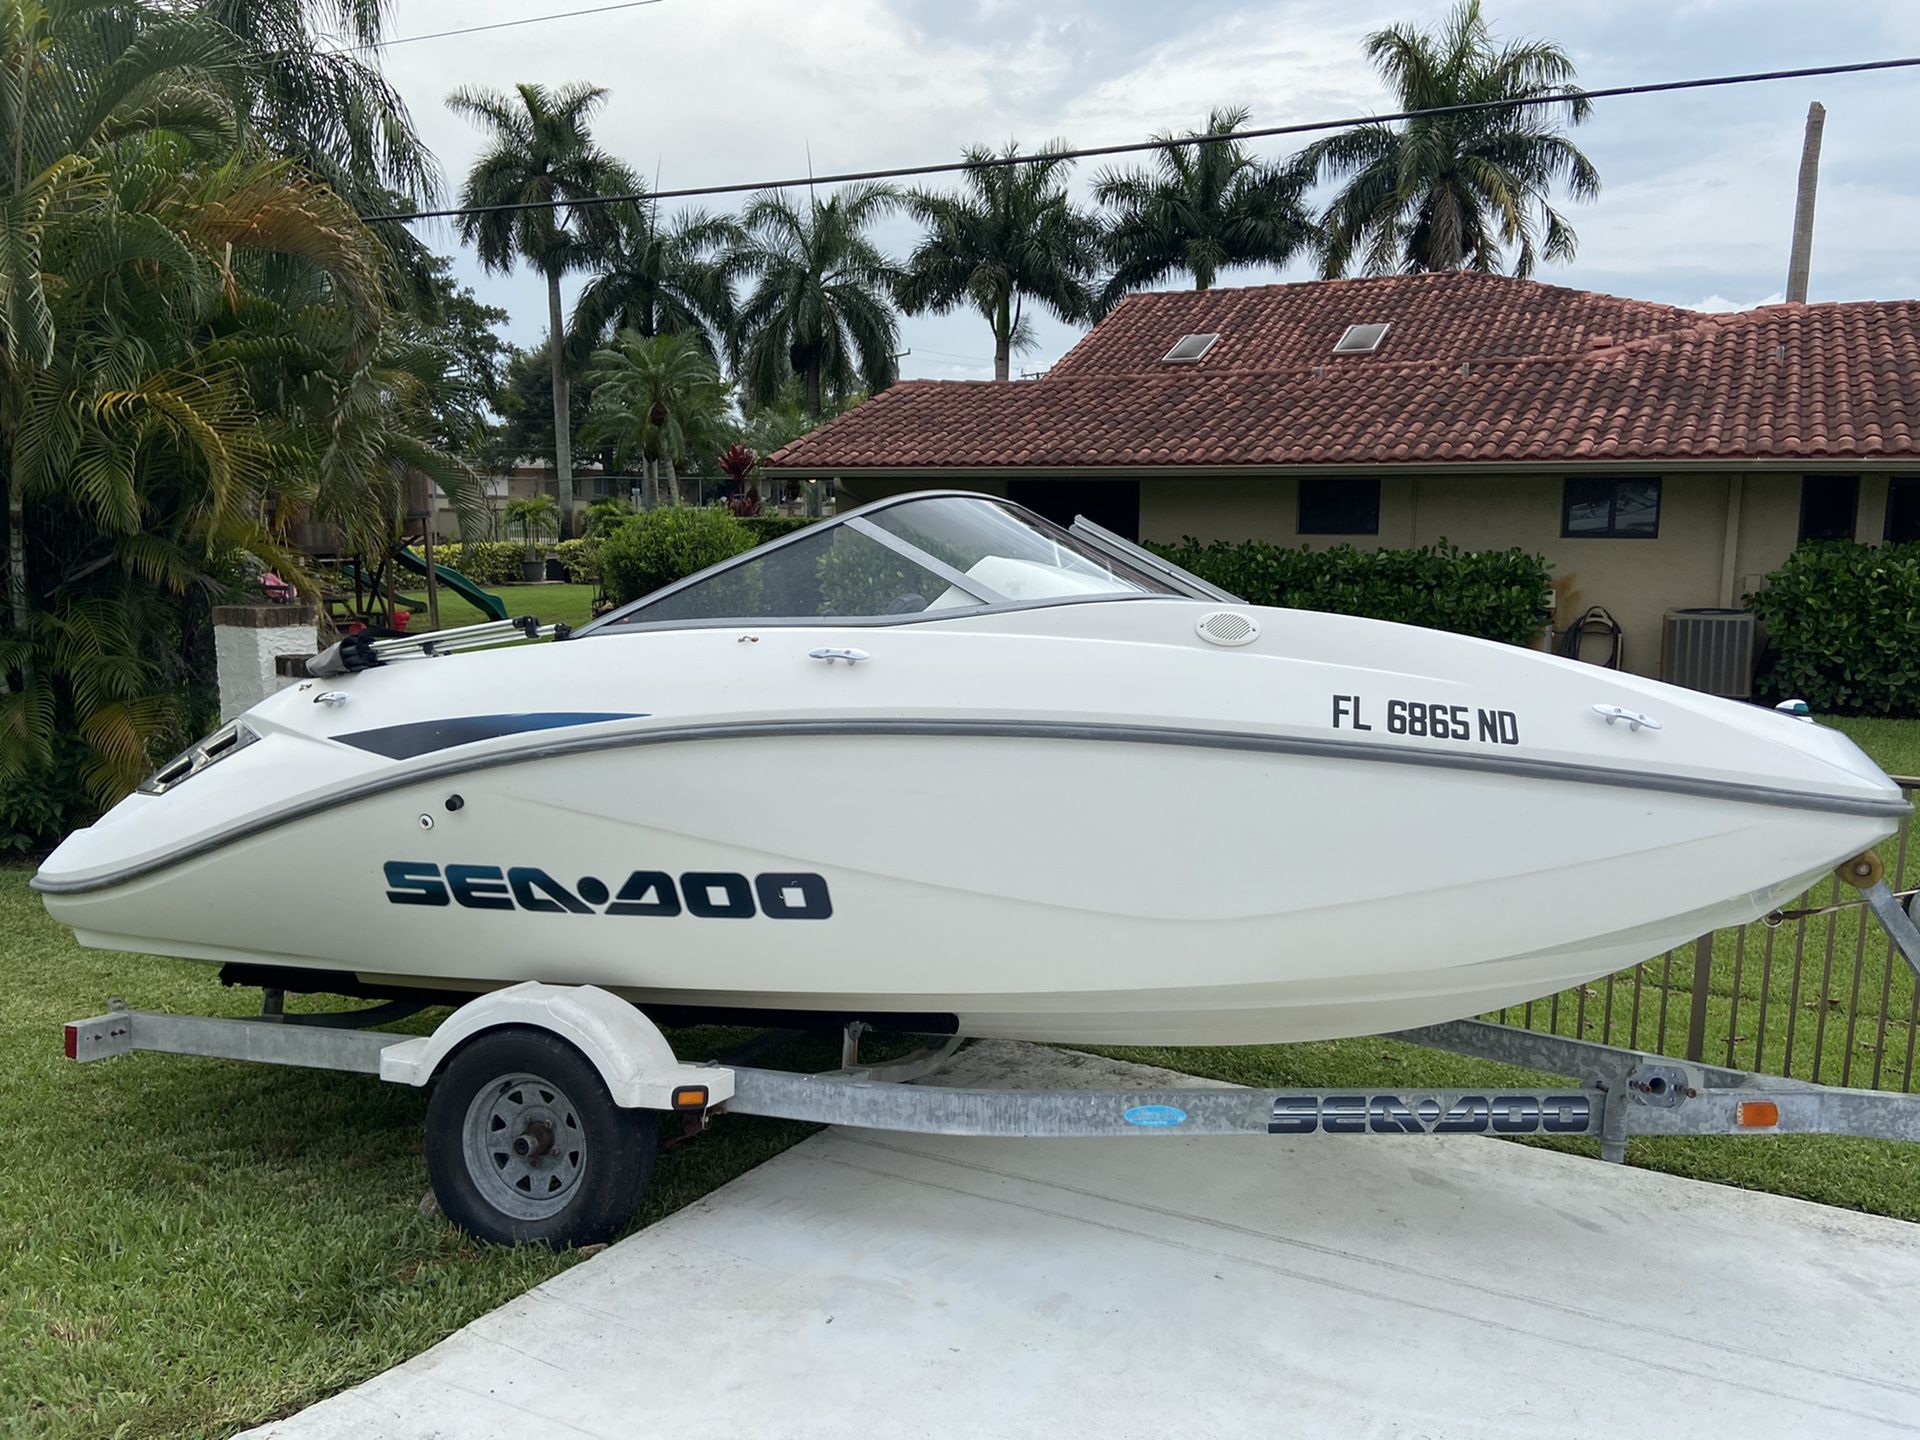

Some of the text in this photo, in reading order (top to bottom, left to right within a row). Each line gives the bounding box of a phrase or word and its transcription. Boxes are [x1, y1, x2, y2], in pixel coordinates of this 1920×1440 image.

[1332, 694, 1519, 745] FL 6865 ND
